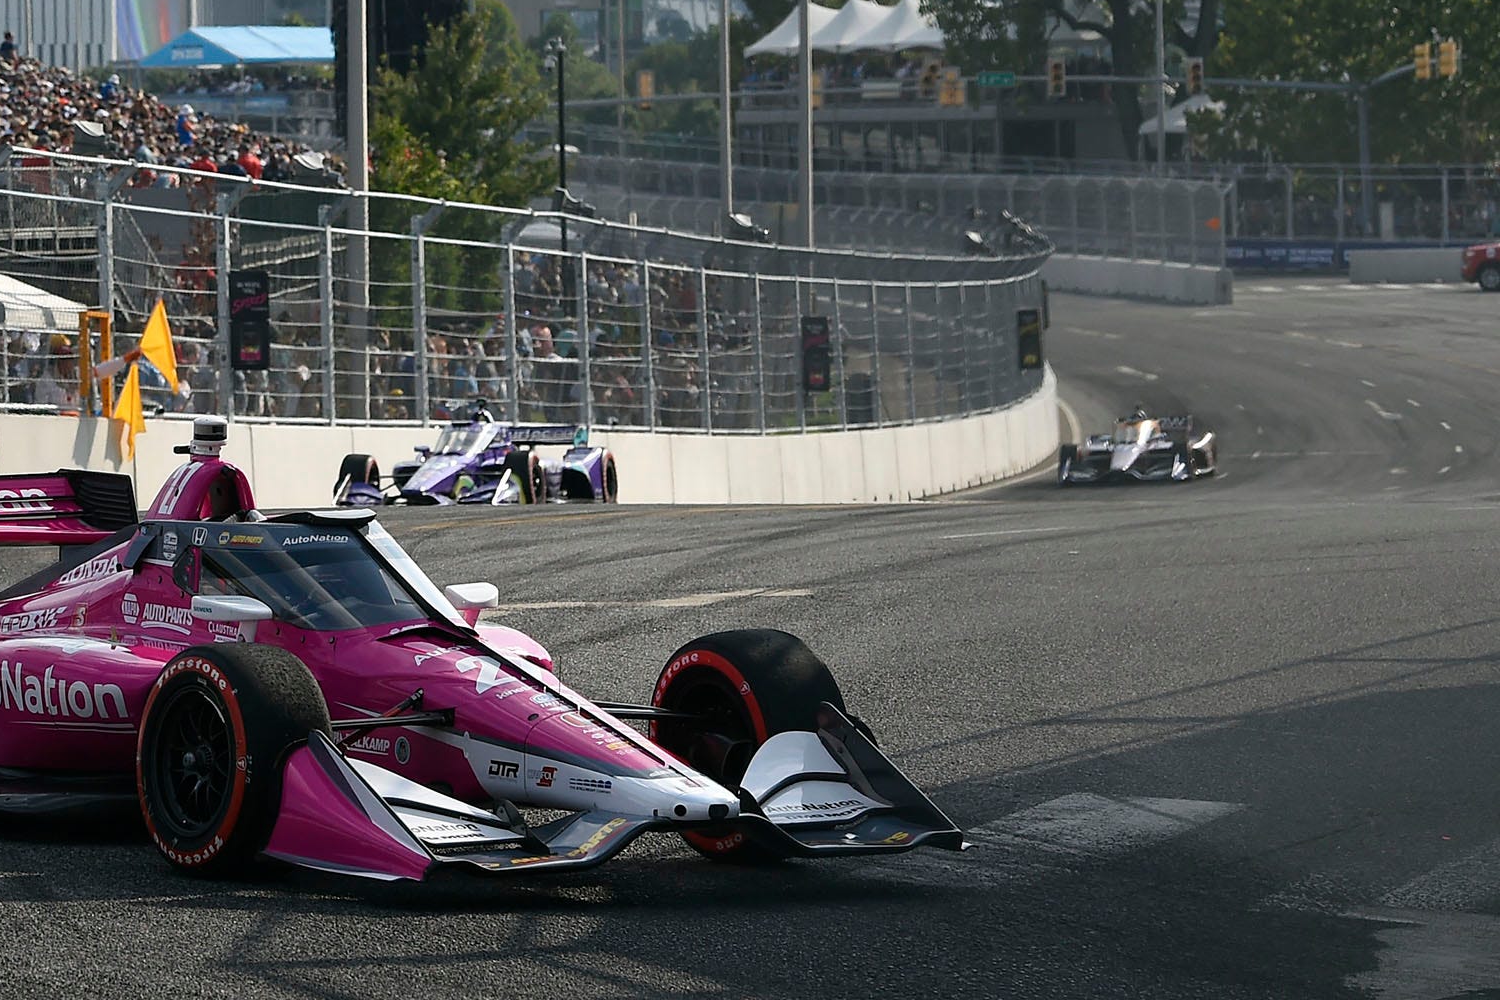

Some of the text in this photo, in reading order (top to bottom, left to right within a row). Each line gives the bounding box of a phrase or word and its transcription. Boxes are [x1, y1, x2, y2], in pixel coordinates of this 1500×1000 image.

[283, 534, 349, 546] AutoNation
[143, 603, 193, 626] AUTO PARTS
[156, 658, 227, 690] Firestone
[767, 799, 862, 813] AutoNation
